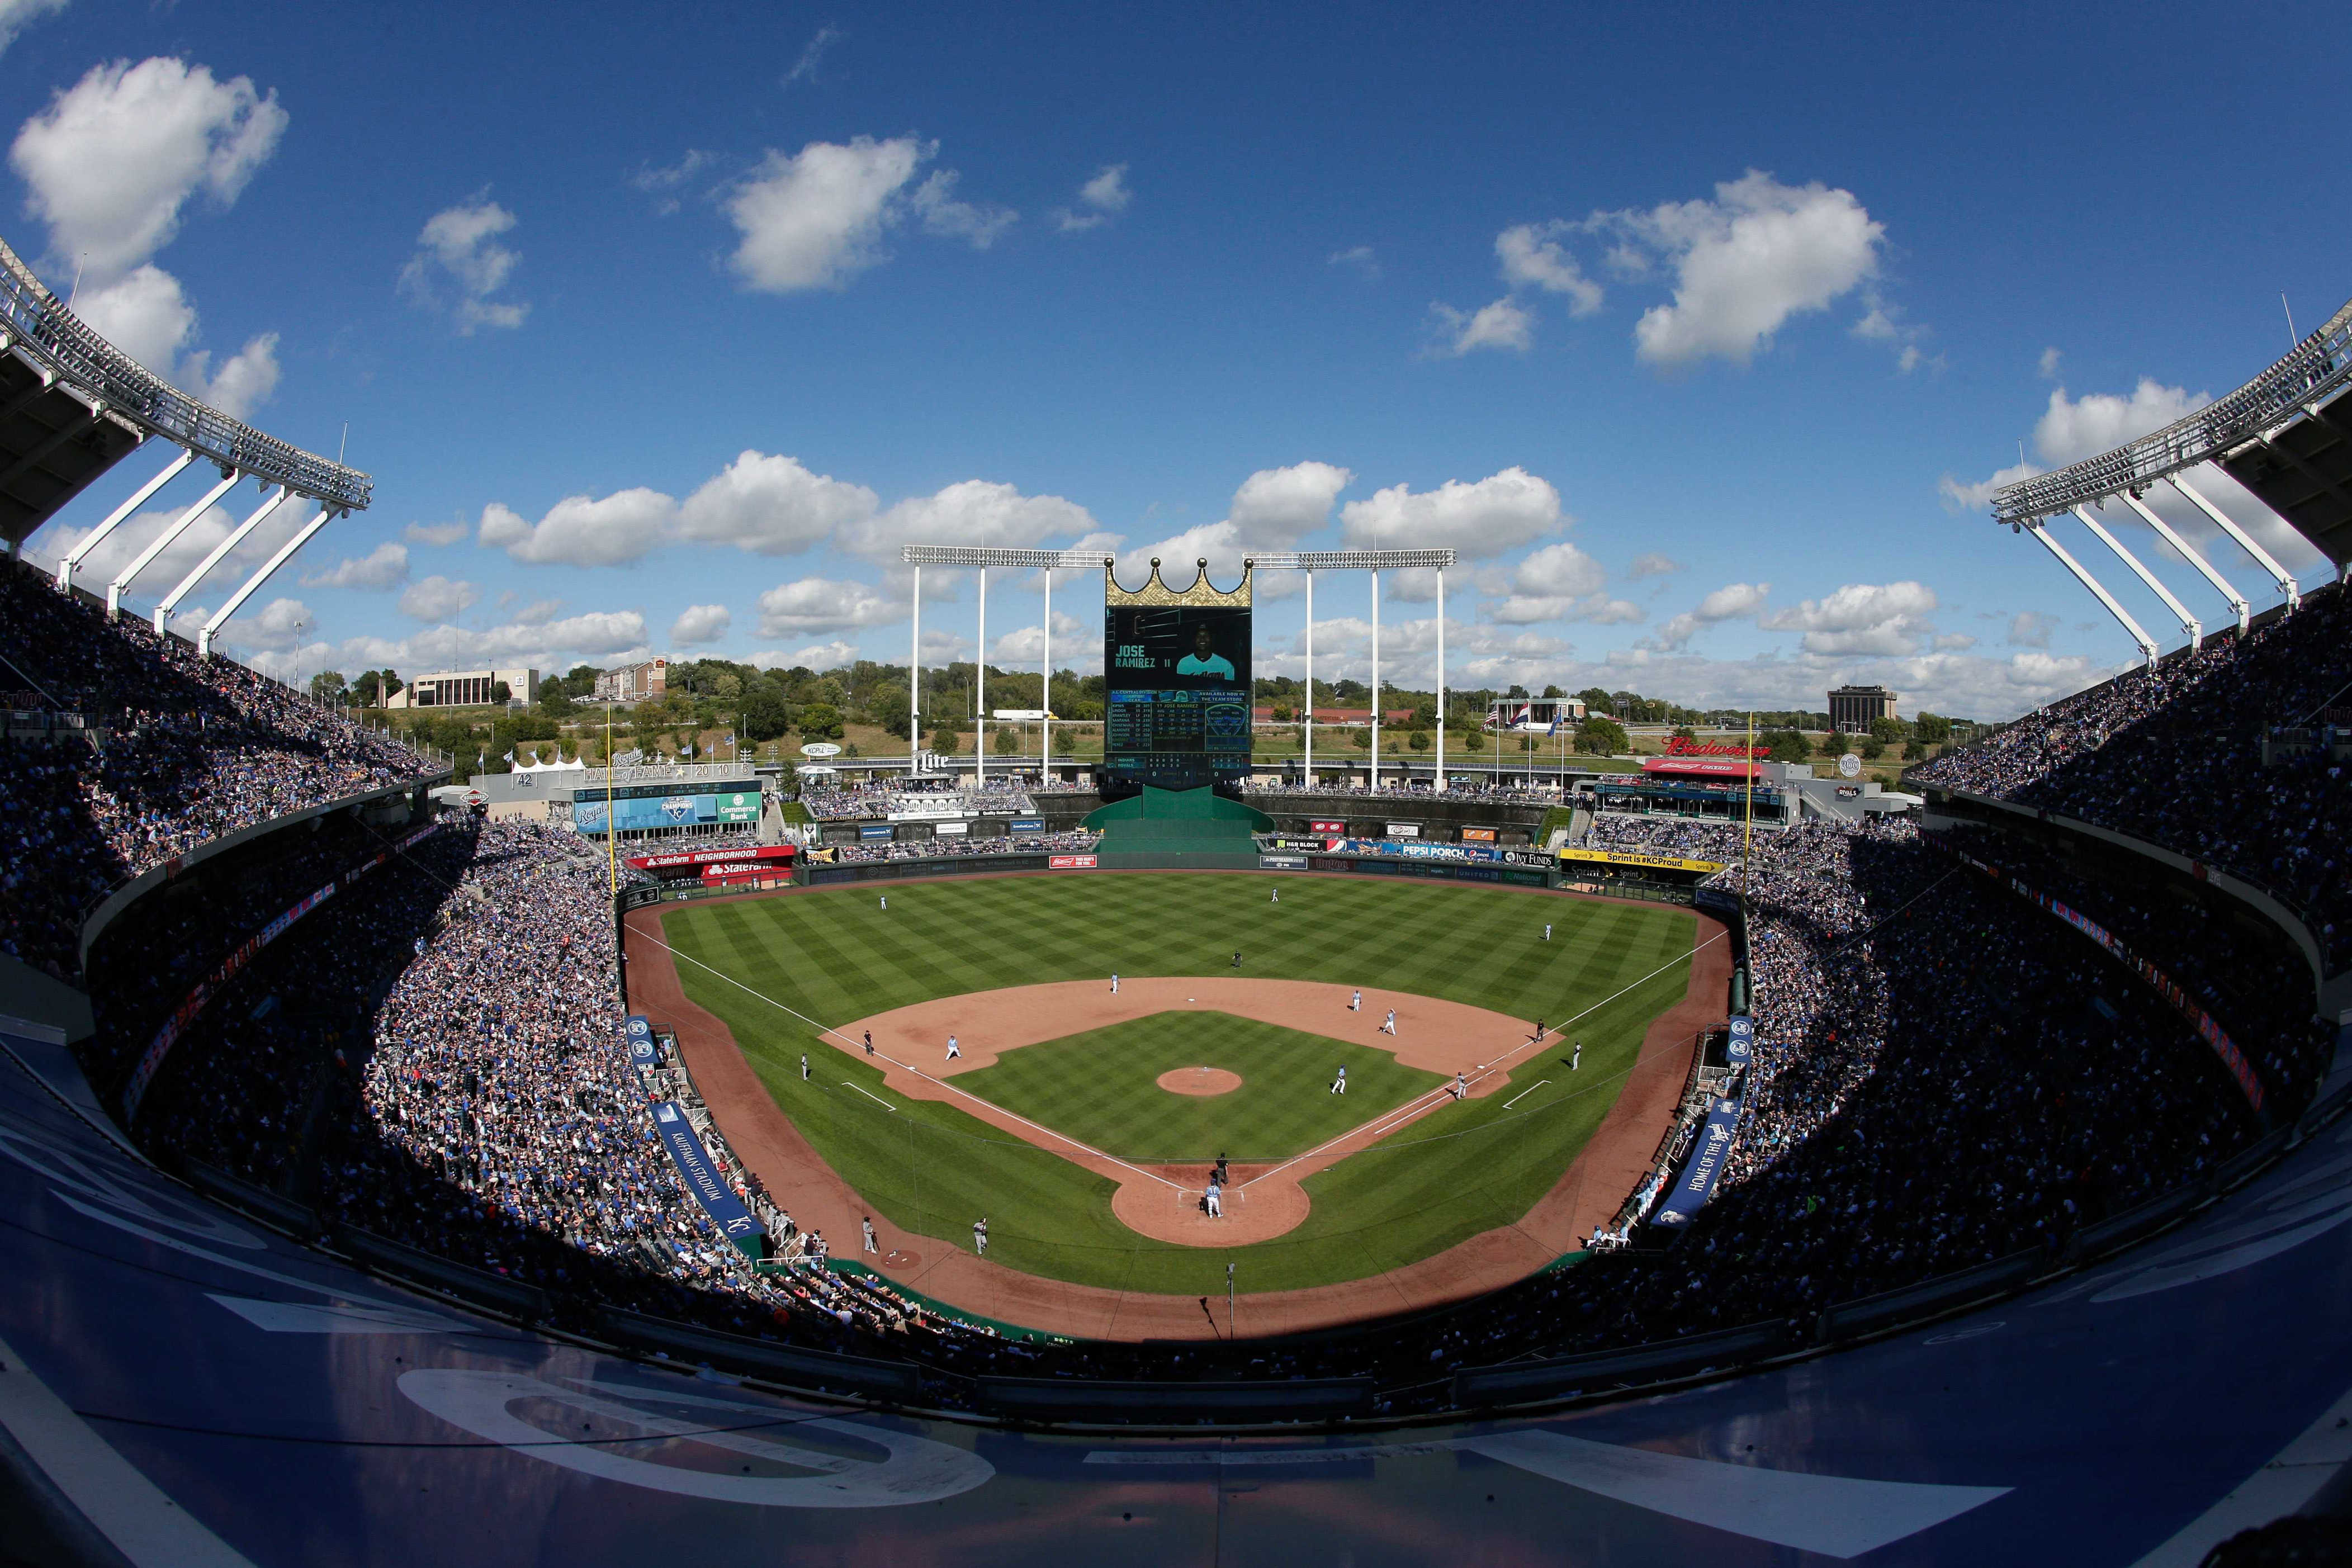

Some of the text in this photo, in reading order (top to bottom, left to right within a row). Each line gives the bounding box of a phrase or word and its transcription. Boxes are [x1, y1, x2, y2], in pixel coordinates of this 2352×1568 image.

[1116, 645, 1145, 657] JOSE
[1115, 658, 1170, 668] RAMIREZ 11
[1662, 736, 1772, 756] Budweiser
[612, 747, 643, 766] Royals
[742, 764, 749, 774] 5
[921, 754, 949, 772] Lite
[1841, 758, 1859, 771] 360
[584, 765, 673, 783] HALL of FAME
[697, 765, 708, 776] 20
[718, 764, 729, 775] 10
[518, 774, 532, 785] 42
[579, 802, 610, 825] Royals
[673, 809, 682, 817] KC
[694, 850, 758, 862] NEIGHBORHOOD
[1403, 846, 1464, 858] PEPSI PORCH
[1607, 853, 1632, 862] Sprint
[1642, 856, 1682, 867] #KCProud
[1513, 873, 1541, 882] National
[1688, 1123, 1730, 1192] HOME OF THE Royals
[671, 1132, 724, 1201] KAUFFMAN STADIUM
[727, 1215, 752, 1233] KC
